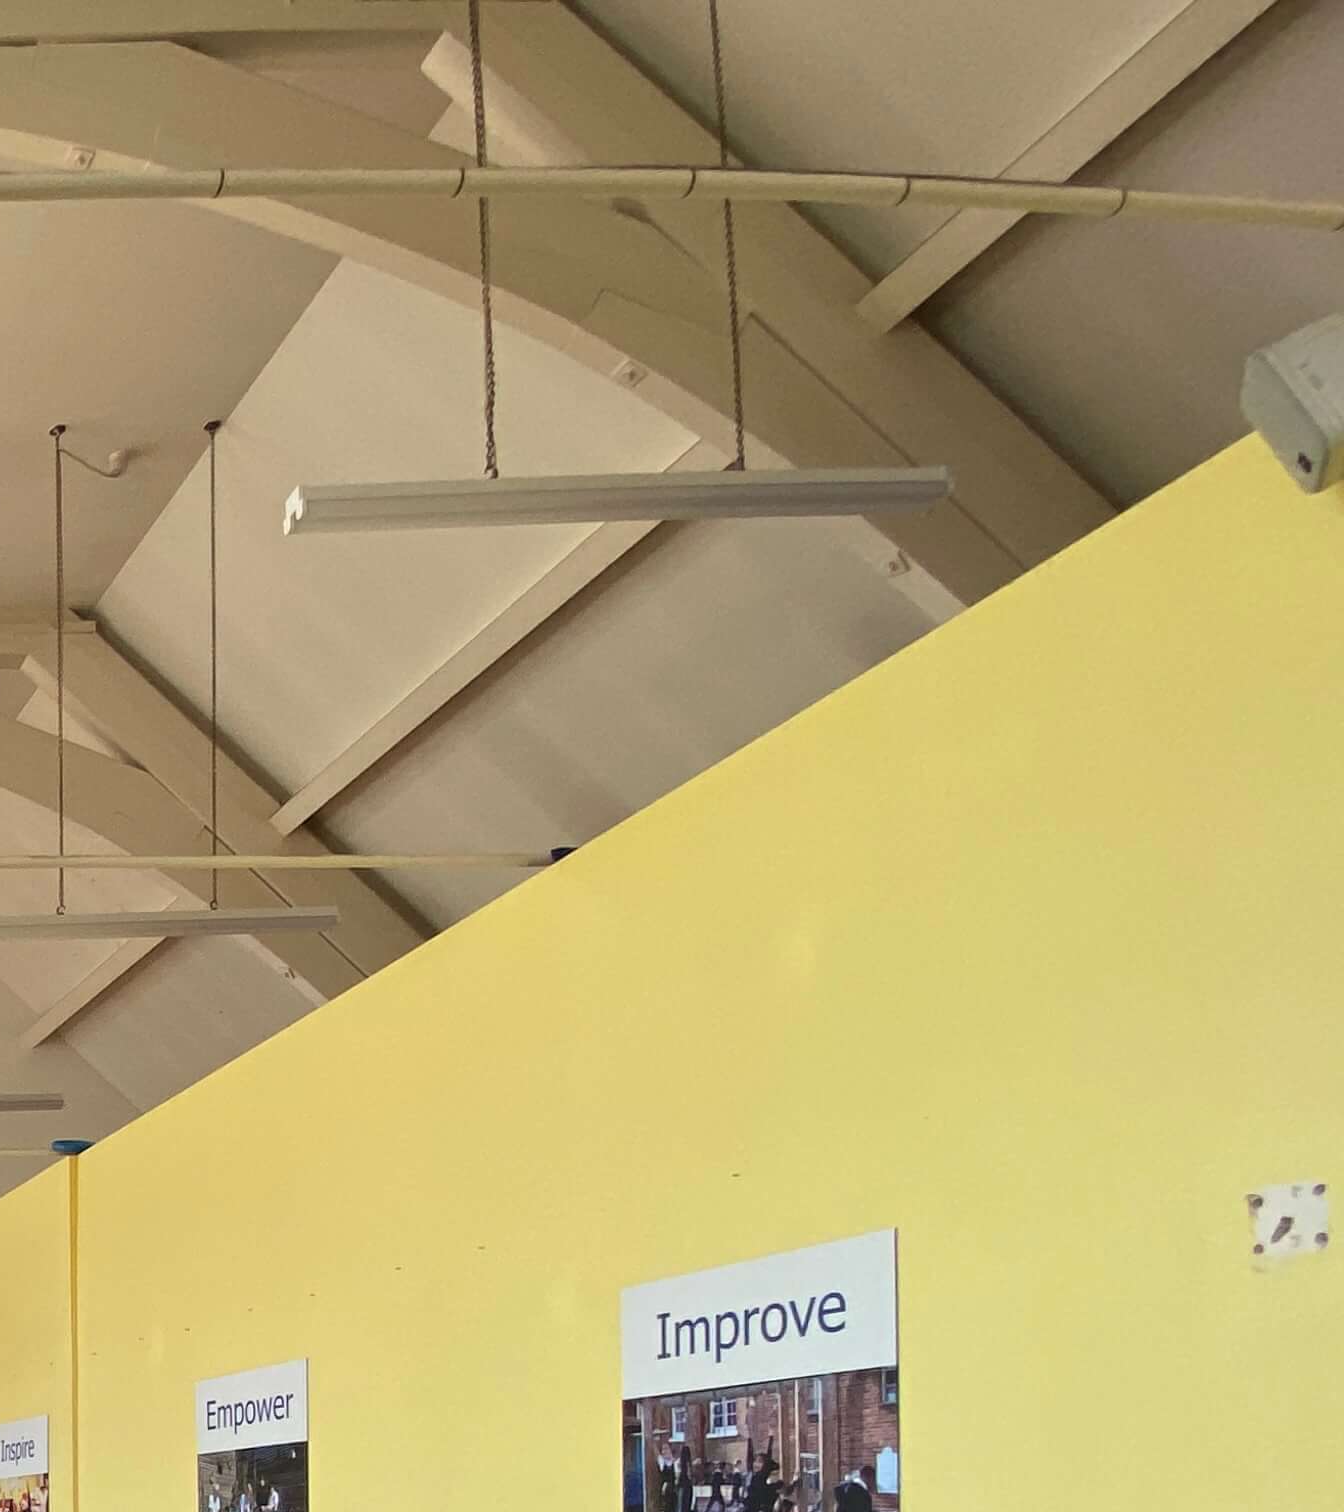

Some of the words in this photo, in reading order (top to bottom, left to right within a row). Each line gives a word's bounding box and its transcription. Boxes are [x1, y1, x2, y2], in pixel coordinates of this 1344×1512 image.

[655, 1289, 847, 1364] Improve
[206, 1390, 295, 1436] Empower
[0, 1436, 36, 1466] Inspire
